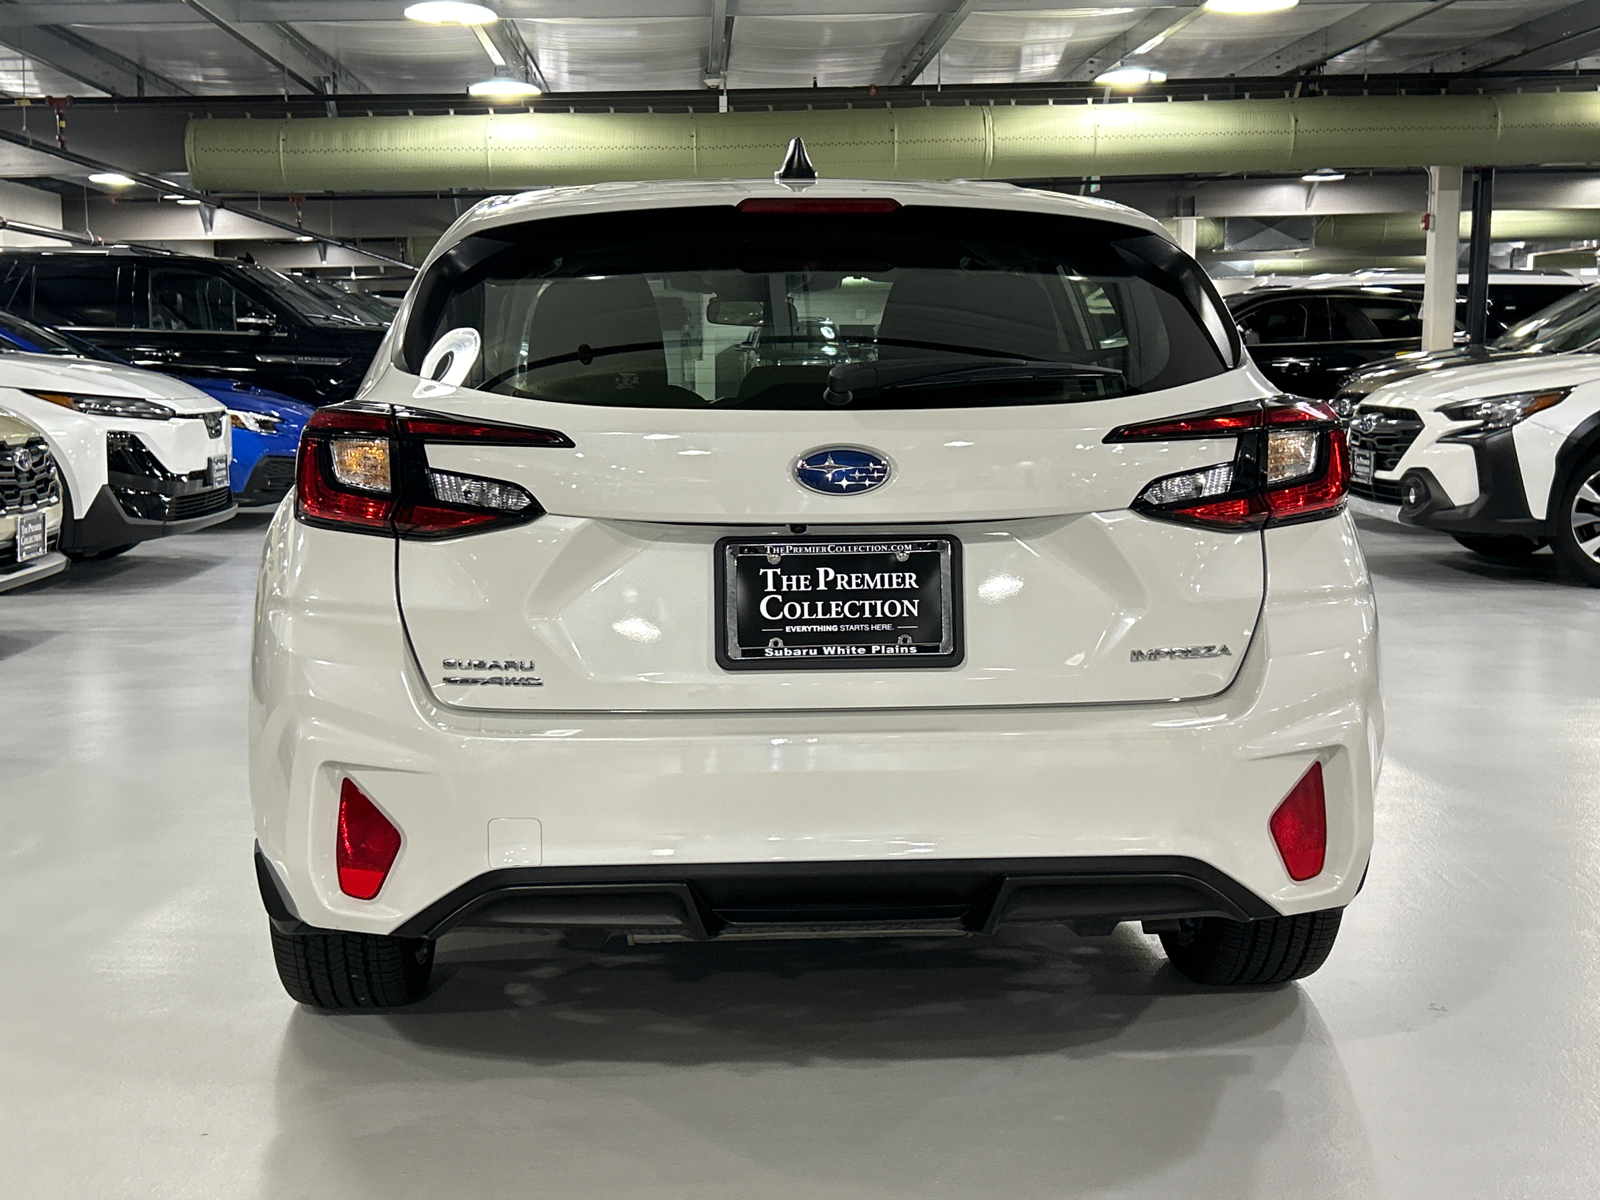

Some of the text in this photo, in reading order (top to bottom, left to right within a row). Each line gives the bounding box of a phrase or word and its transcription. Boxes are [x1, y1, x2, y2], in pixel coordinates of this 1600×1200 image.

[785, 624, 838, 633] EVERYTHING
[839, 624, 870, 632] STARTS
[764, 644, 918, 657] Subaru White Plains
[1130, 644, 1232, 662] IMPREZA
[442, 658, 535, 672] SUBARU
